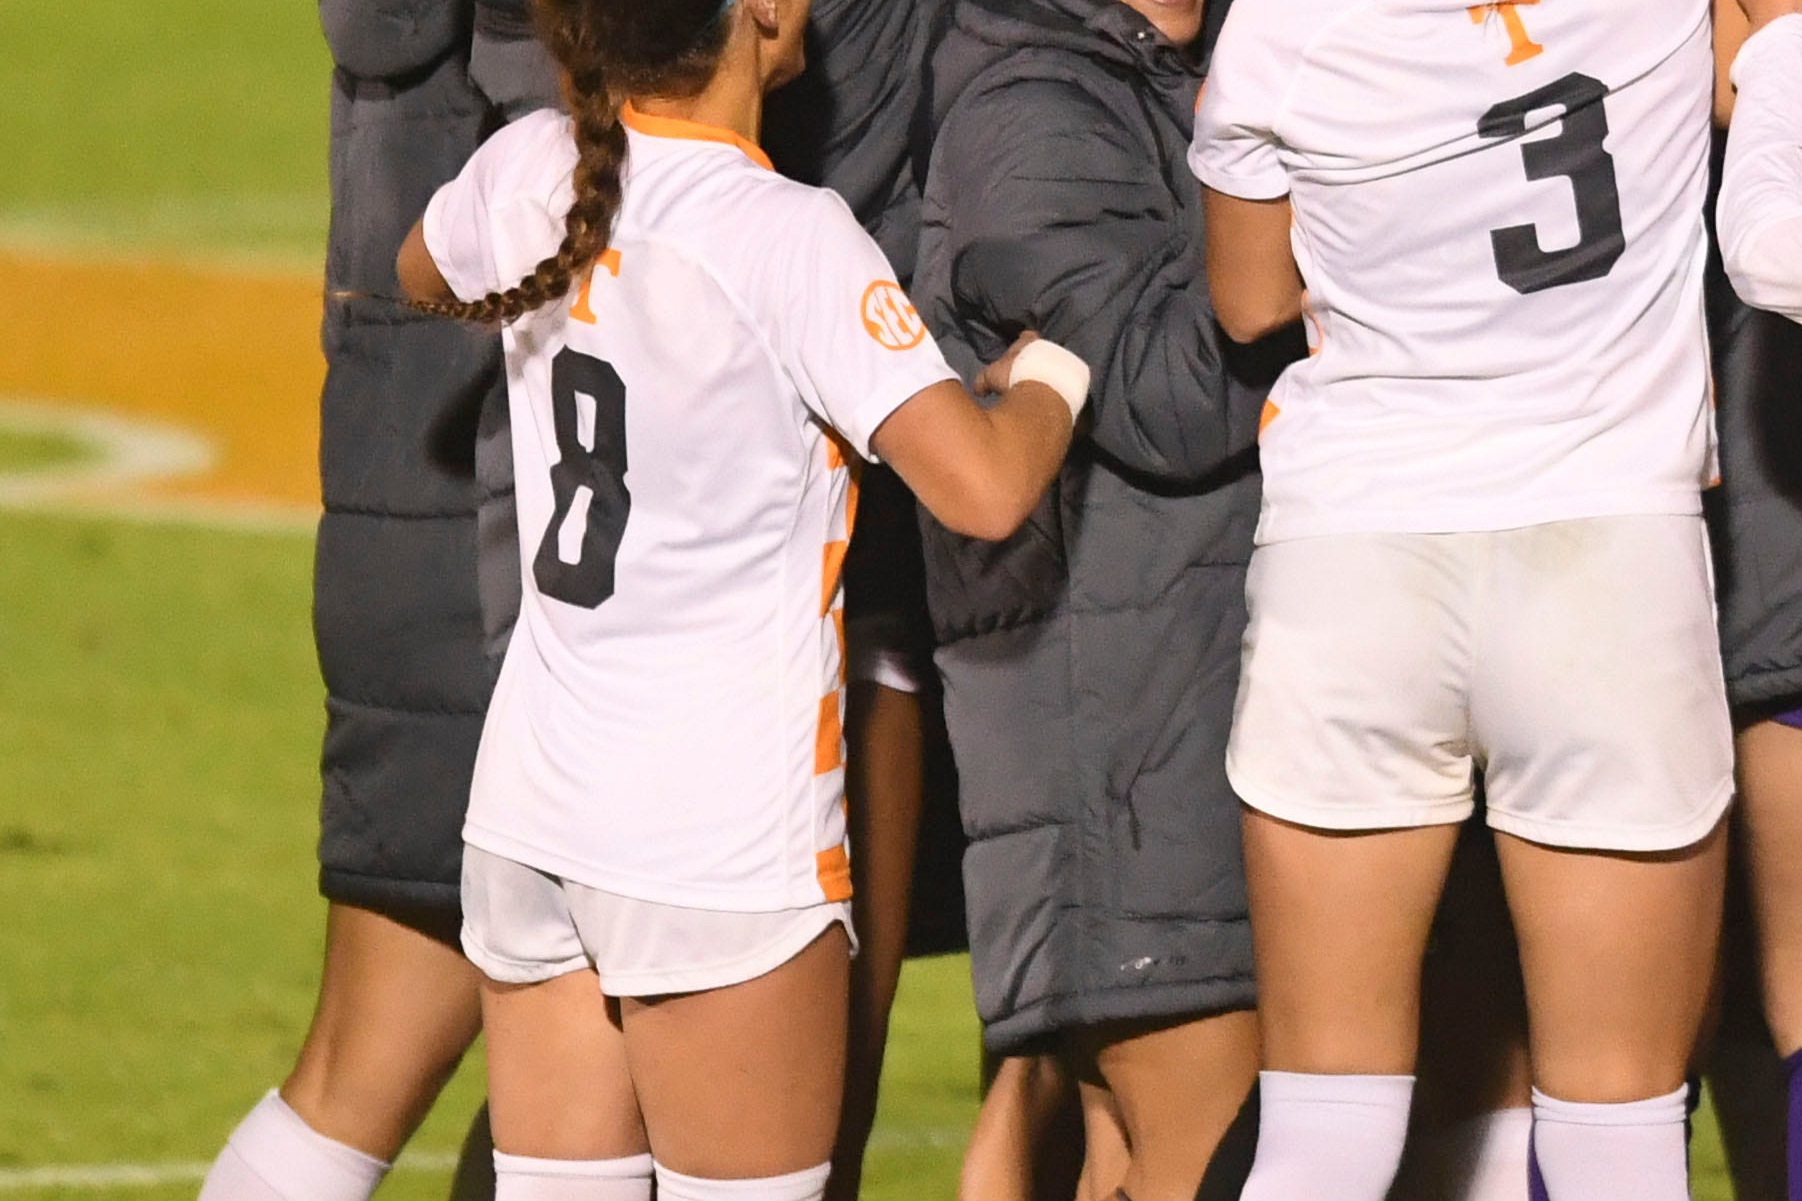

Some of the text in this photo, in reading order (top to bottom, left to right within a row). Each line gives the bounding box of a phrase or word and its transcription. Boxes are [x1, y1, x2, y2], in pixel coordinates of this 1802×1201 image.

[1477, 71, 1626, 295] 3
[864, 285, 922, 348] SEC
[533, 343, 632, 610] 8
